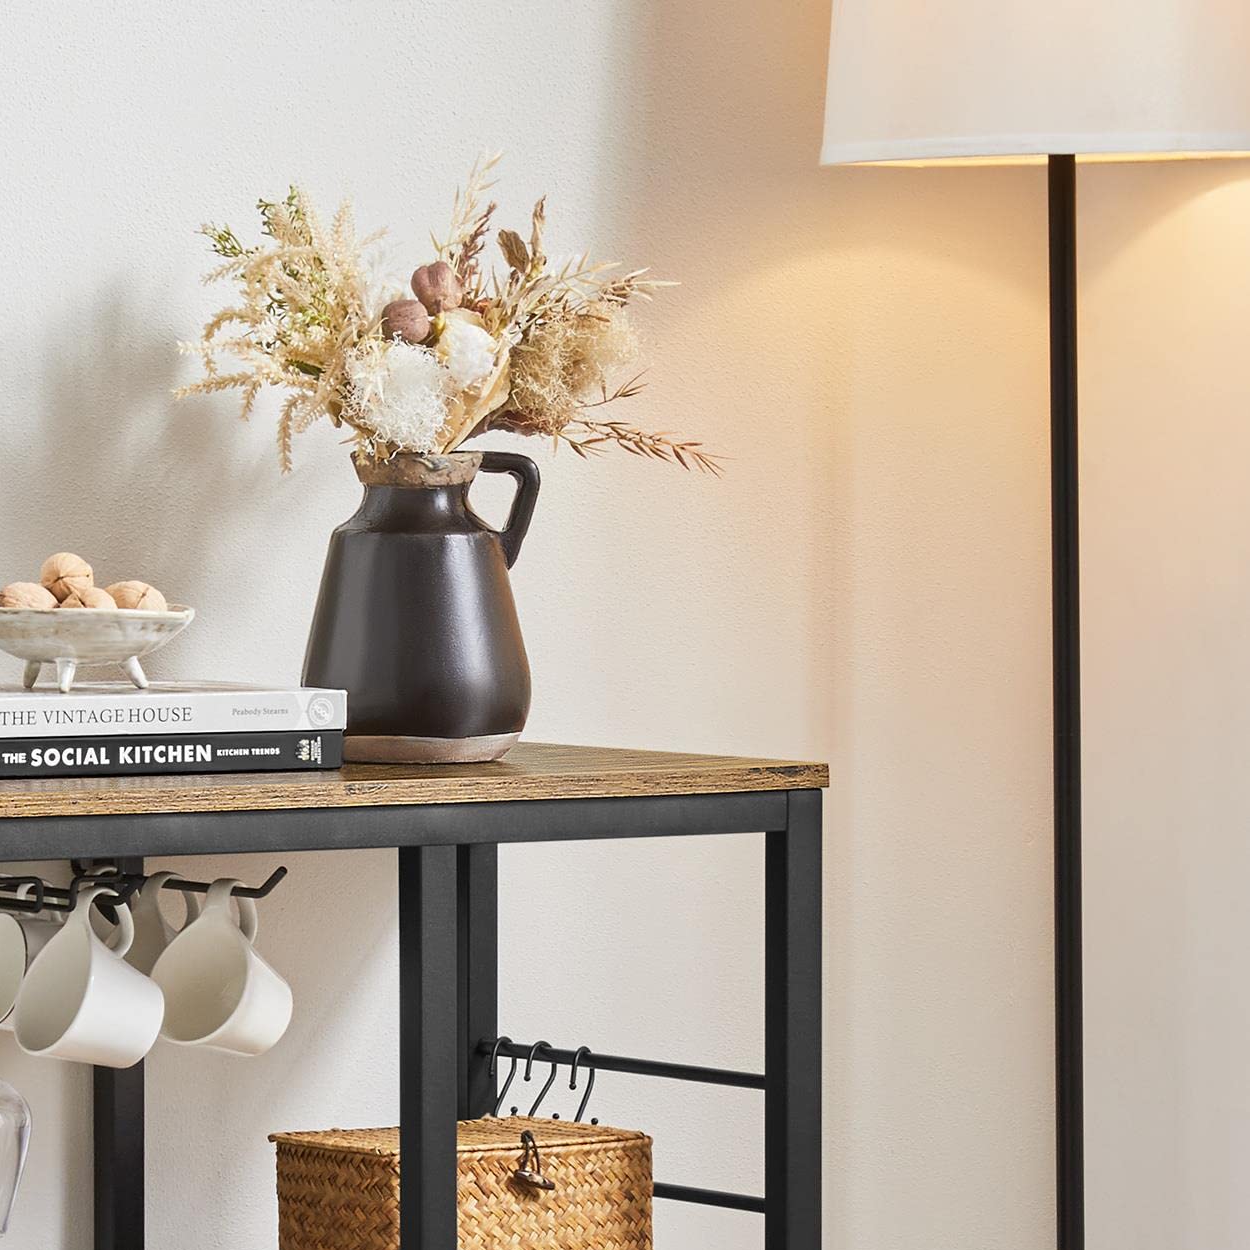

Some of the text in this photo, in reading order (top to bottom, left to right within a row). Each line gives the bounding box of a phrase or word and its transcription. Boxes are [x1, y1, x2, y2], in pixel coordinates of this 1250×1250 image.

[0, 706, 193, 726] THE VINTAGE HOUSE
[231, 707, 261, 717] Peabody
[1, 743, 212, 766] THE SOCIAL KITCHEN
[216, 747, 281, 757] KITCHEN TRENDS
